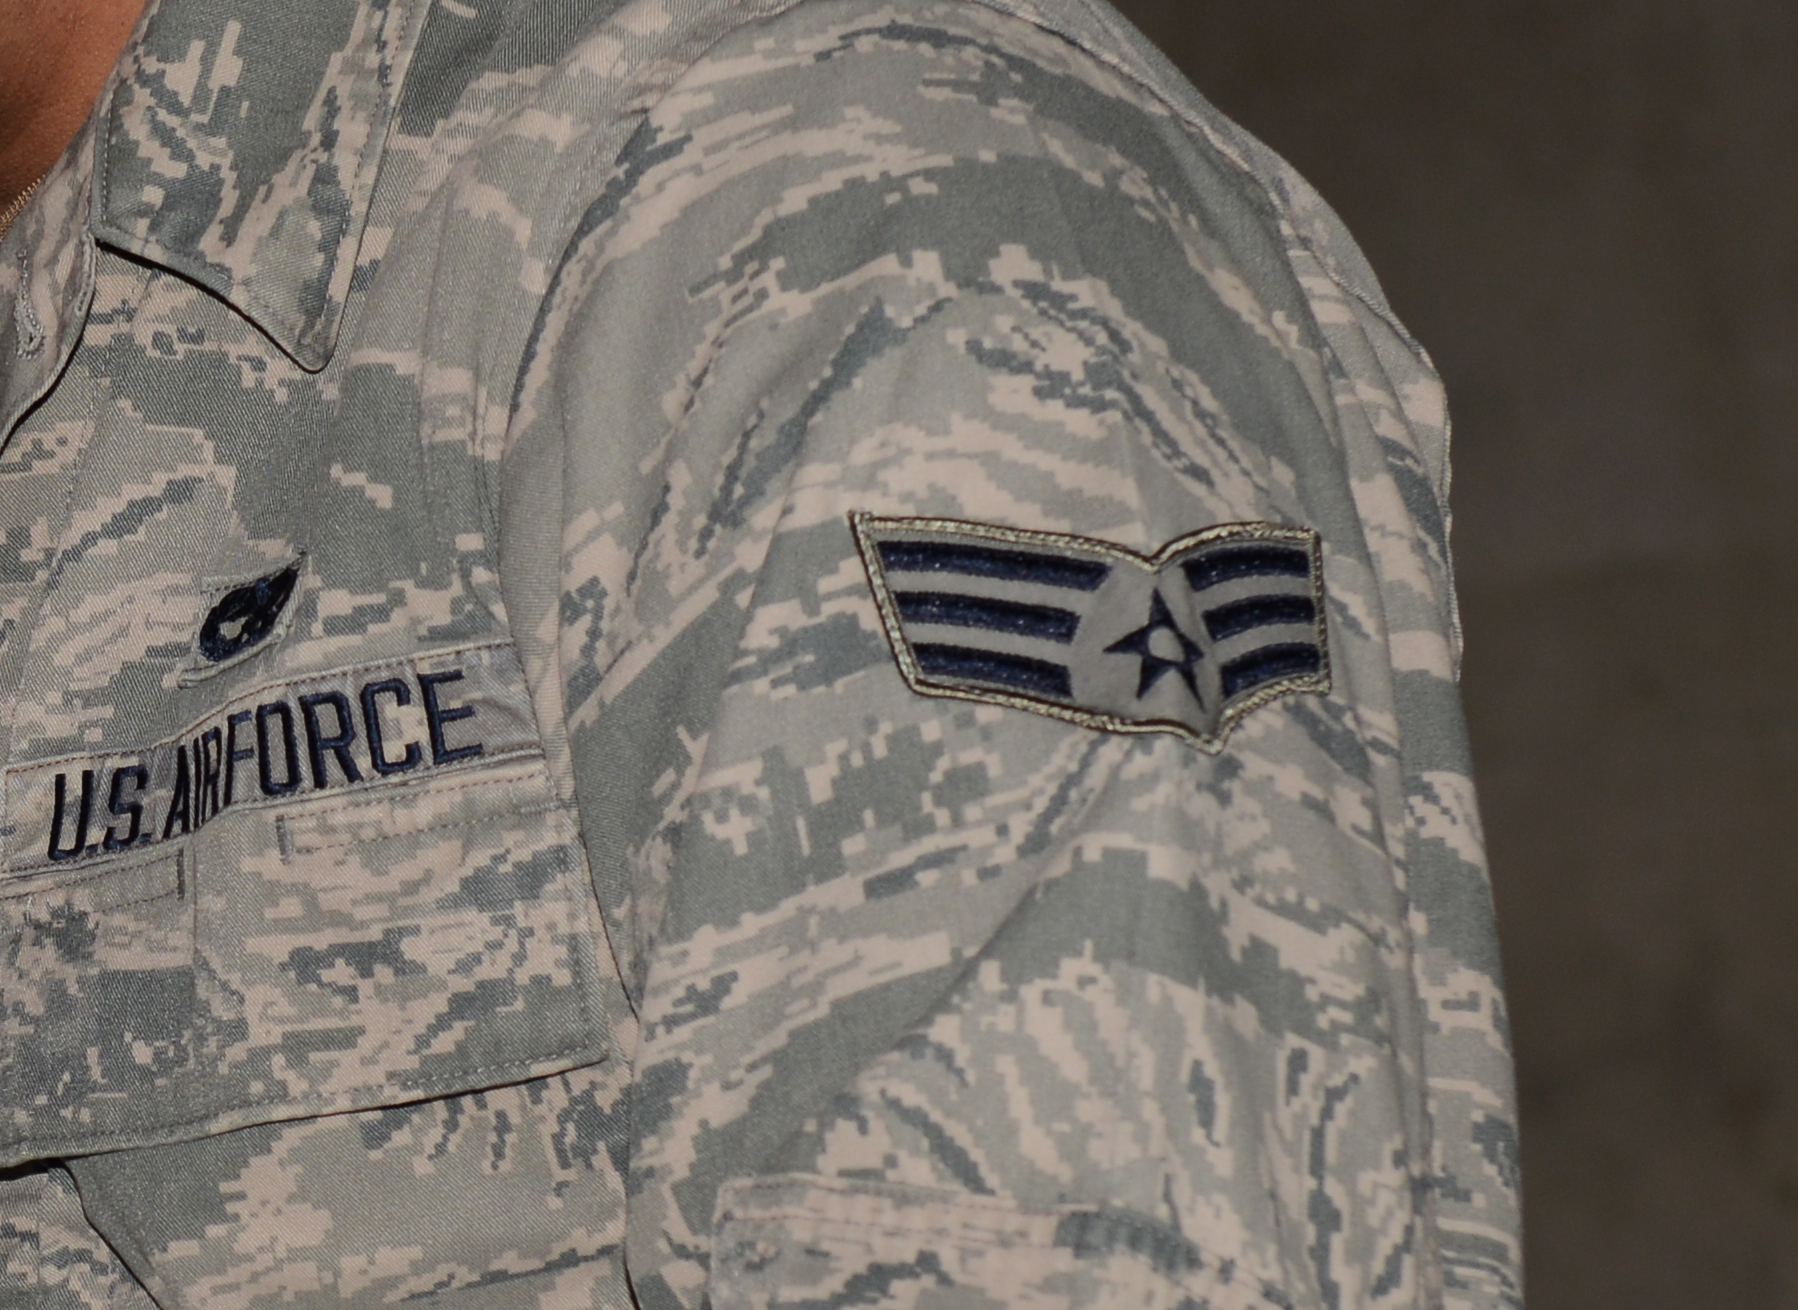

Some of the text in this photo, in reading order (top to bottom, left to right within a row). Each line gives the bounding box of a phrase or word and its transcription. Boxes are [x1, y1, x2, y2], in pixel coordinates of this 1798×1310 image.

[45, 668, 484, 861] U.S. AIR FORCE
